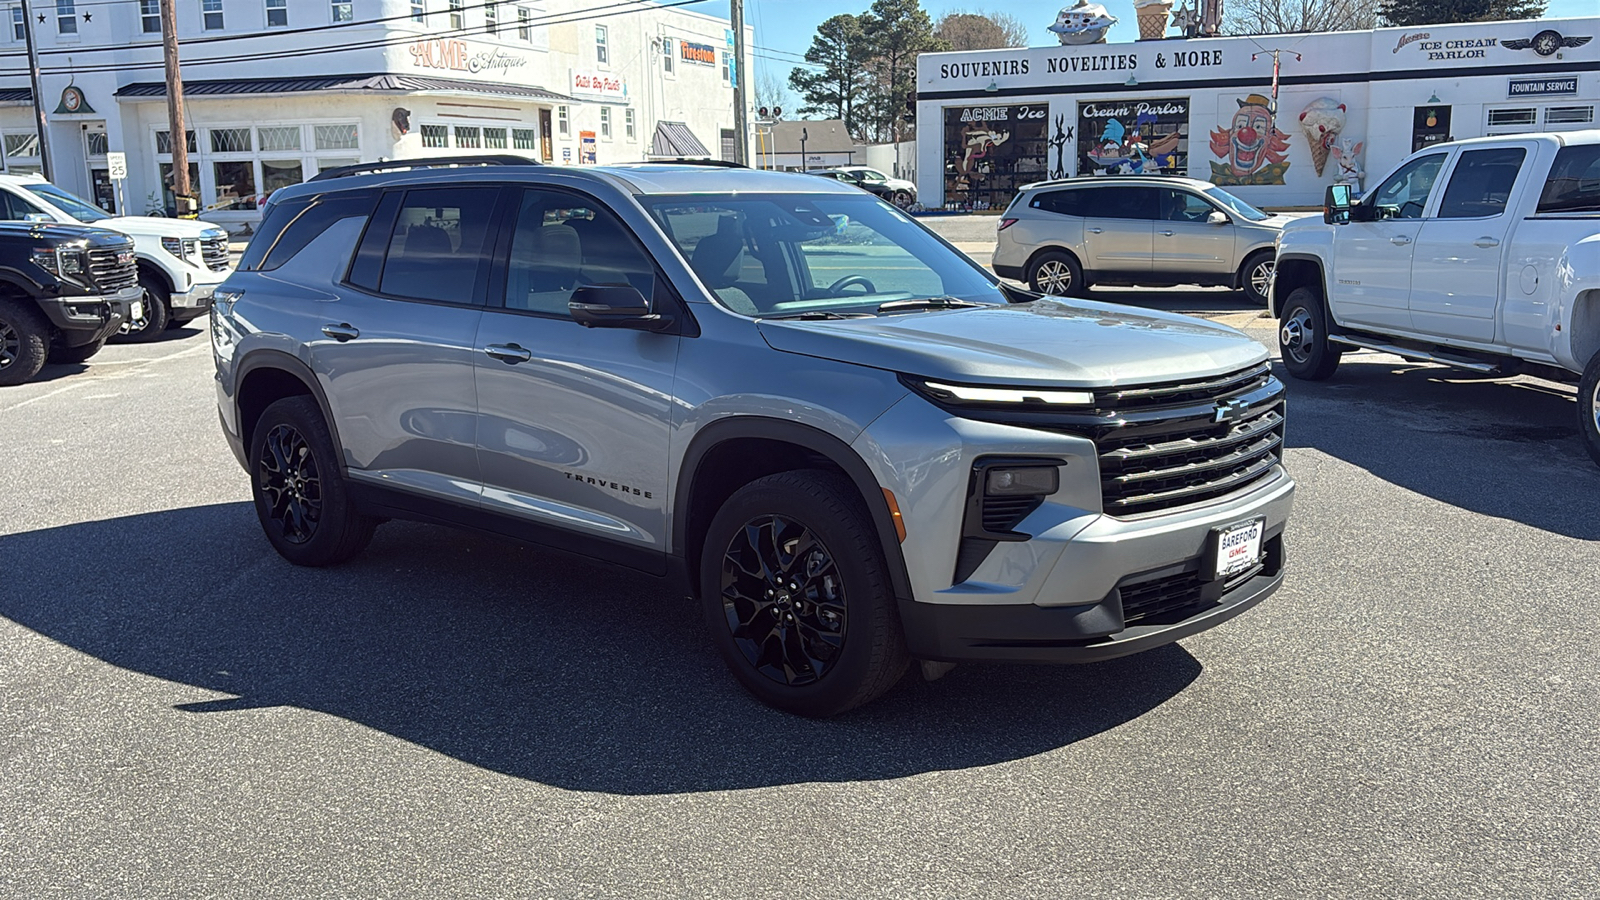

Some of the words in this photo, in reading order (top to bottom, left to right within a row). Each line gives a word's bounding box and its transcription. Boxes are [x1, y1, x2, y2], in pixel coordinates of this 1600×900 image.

[1420, 41, 1442, 51] ICE
[1445, 38, 1498, 49] CREAM
[409, 39, 469, 72] ACME
[468, 47, 527, 76] Antiques
[1428, 50, 1485, 60] PARLOR
[940, 59, 1029, 79] SOUVENIRS
[1047, 54, 1138, 73] NOVELTIES
[1155, 52, 1167, 69] &
[1173, 50, 1223, 67] MORE
[575, 75, 590, 88] Dutch
[592, 77, 603, 92] Boy
[1511, 82, 1546, 93] FOUNTAIN
[1546, 81, 1575, 91] SERVICE
[960, 107, 1008, 122] ACME
[1017, 106, 1046, 120] Ice
[1082, 104, 1130, 118] Cream
[1136, 102, 1186, 116] Parlor
[111, 166, 125, 175] 25
[564, 472, 652, 499] TRAVERSE
[1222, 528, 1258, 550] BAREFORD
[1229, 545, 1248, 558] GMC
